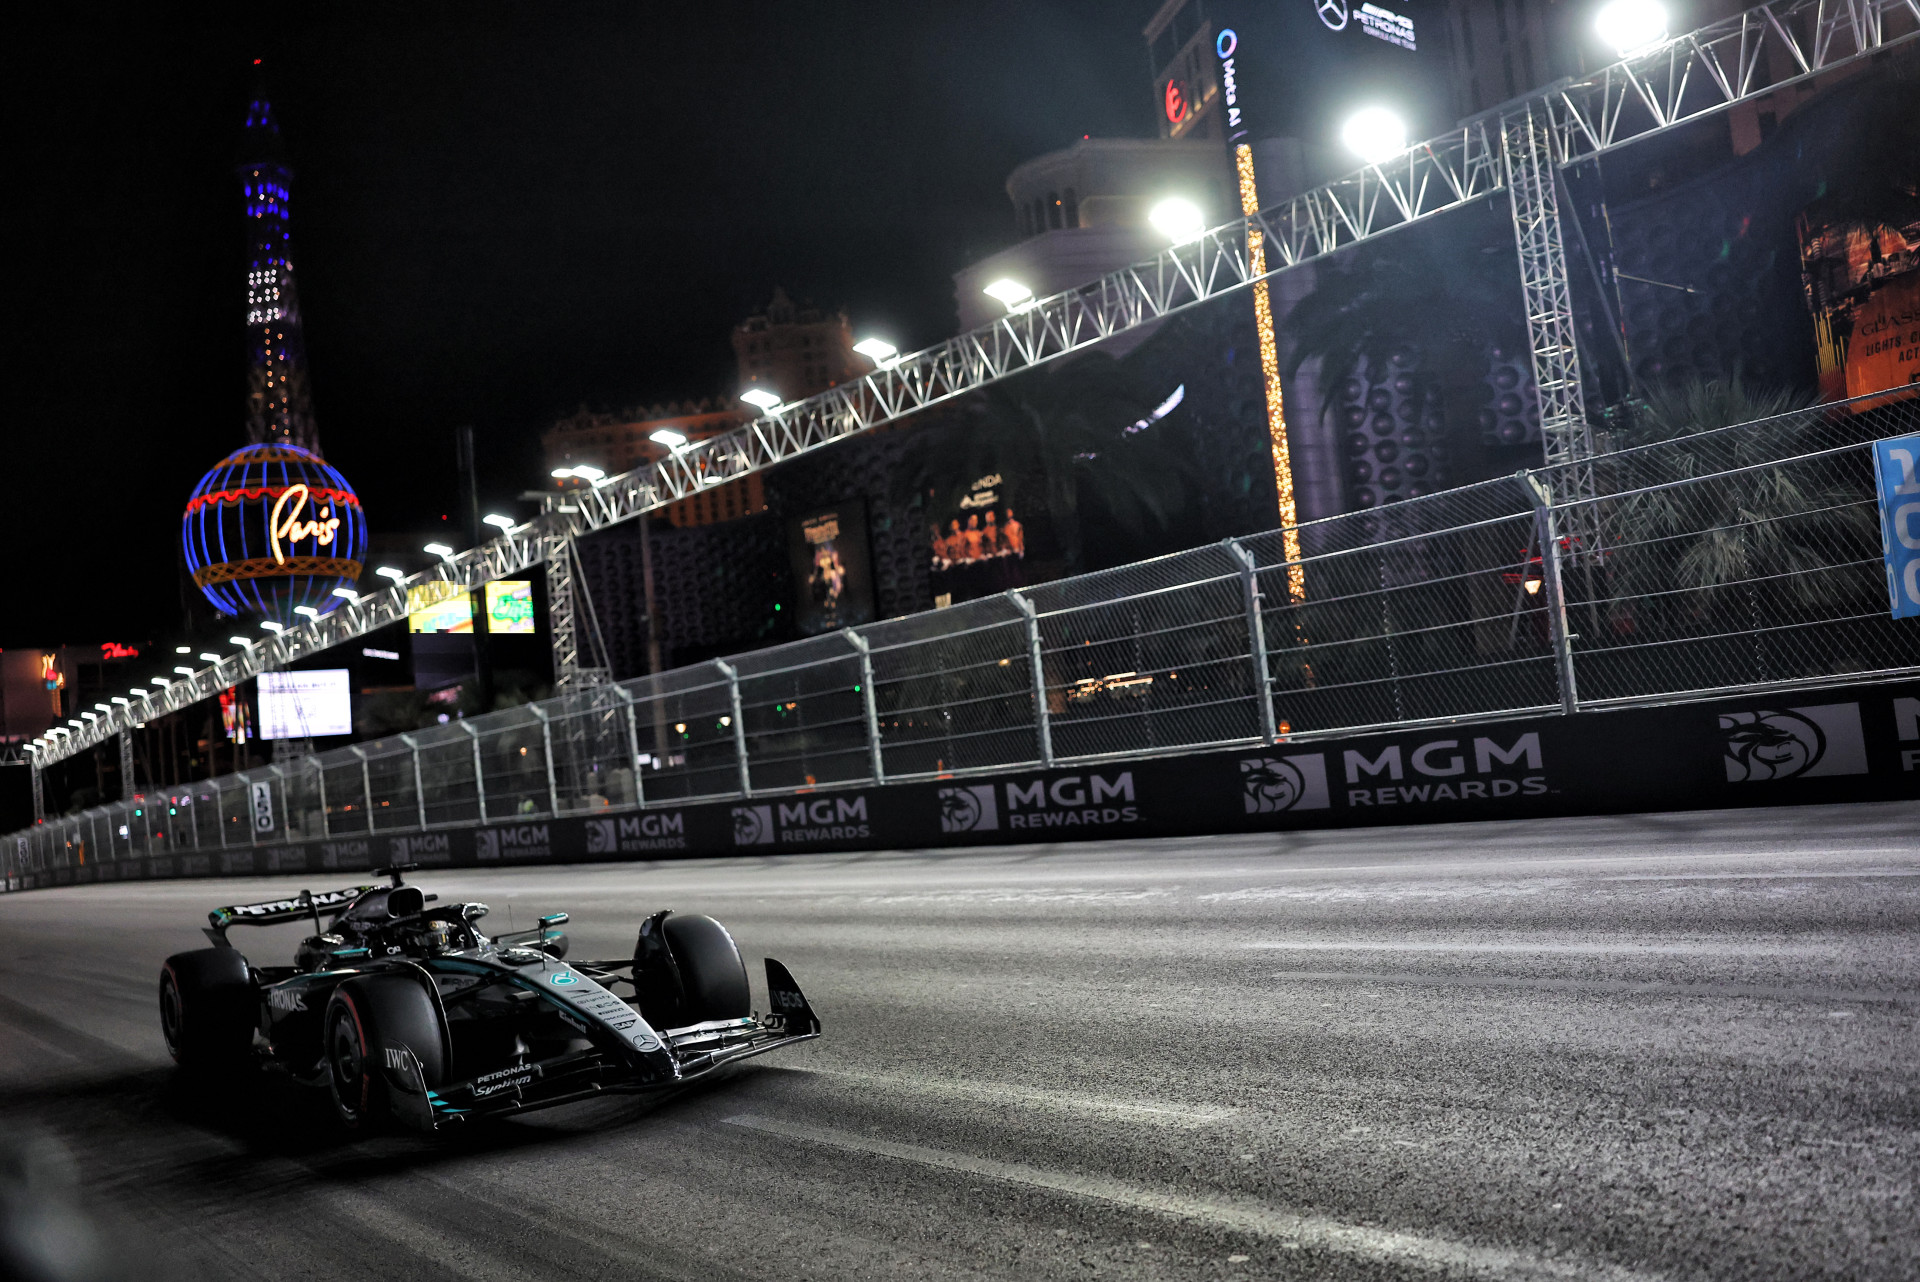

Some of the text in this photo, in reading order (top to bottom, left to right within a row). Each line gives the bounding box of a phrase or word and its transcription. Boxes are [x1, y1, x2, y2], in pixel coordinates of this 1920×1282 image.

[1353, 9, 1415, 42] PETRONAS
[1222, 58, 1242, 127] Meta AI
[270, 483, 340, 565] Paris
[1343, 732, 1543, 784] MGM
[1006, 771, 1135, 810] MGM
[1348, 776, 1548, 807] REWARDS
[257, 786, 270, 828] 150
[778, 795, 868, 827] MGM
[1010, 807, 1139, 829] REWARDS
[501, 825, 550, 845] MGM
[619, 812, 684, 837] MGM
[782, 824, 870, 842] REWARDS
[410, 834, 449, 853] MGM
[622, 836, 686, 851] REWARDS
[615, 1021, 635, 1030] SAP
[385, 1048, 409, 1071] IWC
[477, 1063, 532, 1084] PETRONAS
[475, 1075, 532, 1097] Syntium
